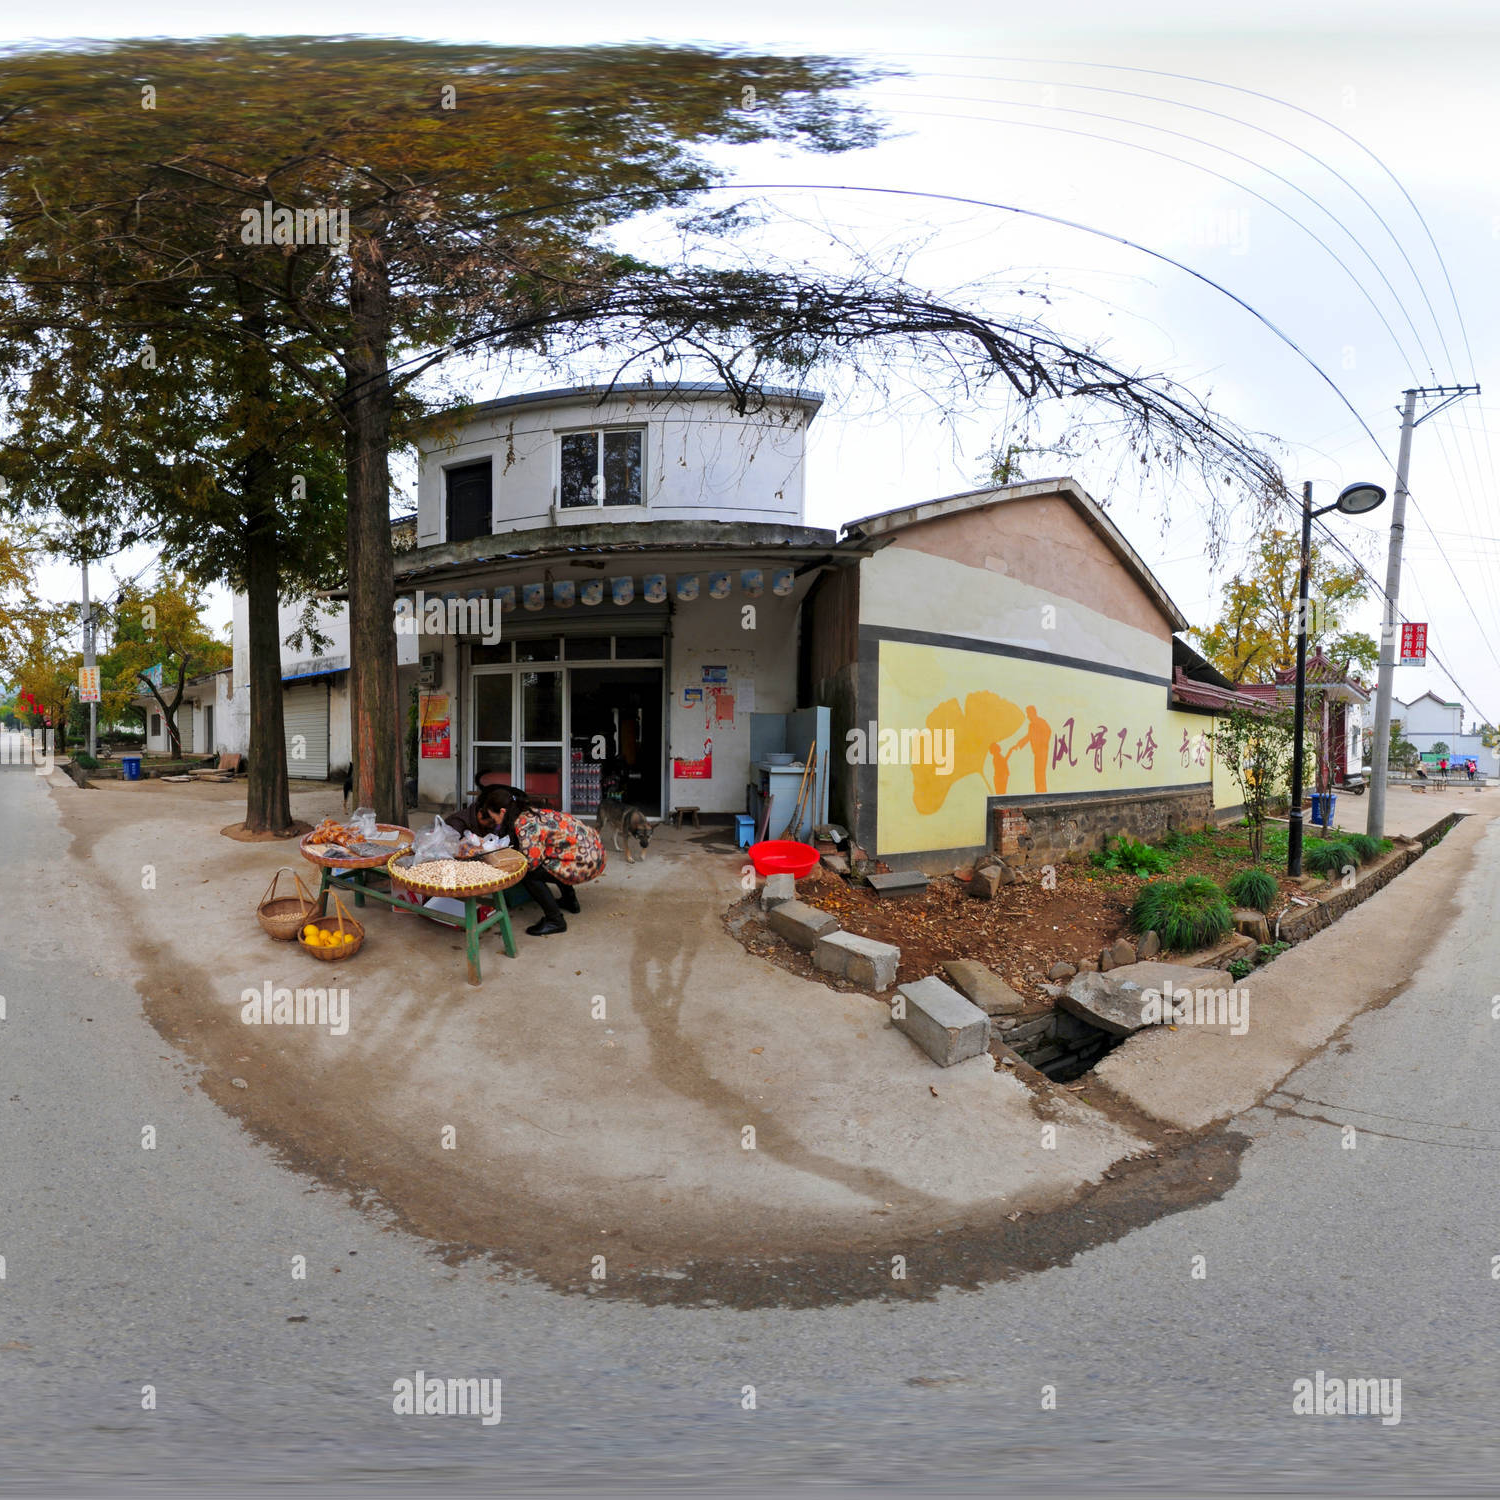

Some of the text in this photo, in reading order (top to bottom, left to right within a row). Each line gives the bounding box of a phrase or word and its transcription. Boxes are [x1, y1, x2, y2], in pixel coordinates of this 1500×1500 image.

[1403, 625, 1413, 657] 科学用电
[1415, 625, 1425, 657] 依法用电
